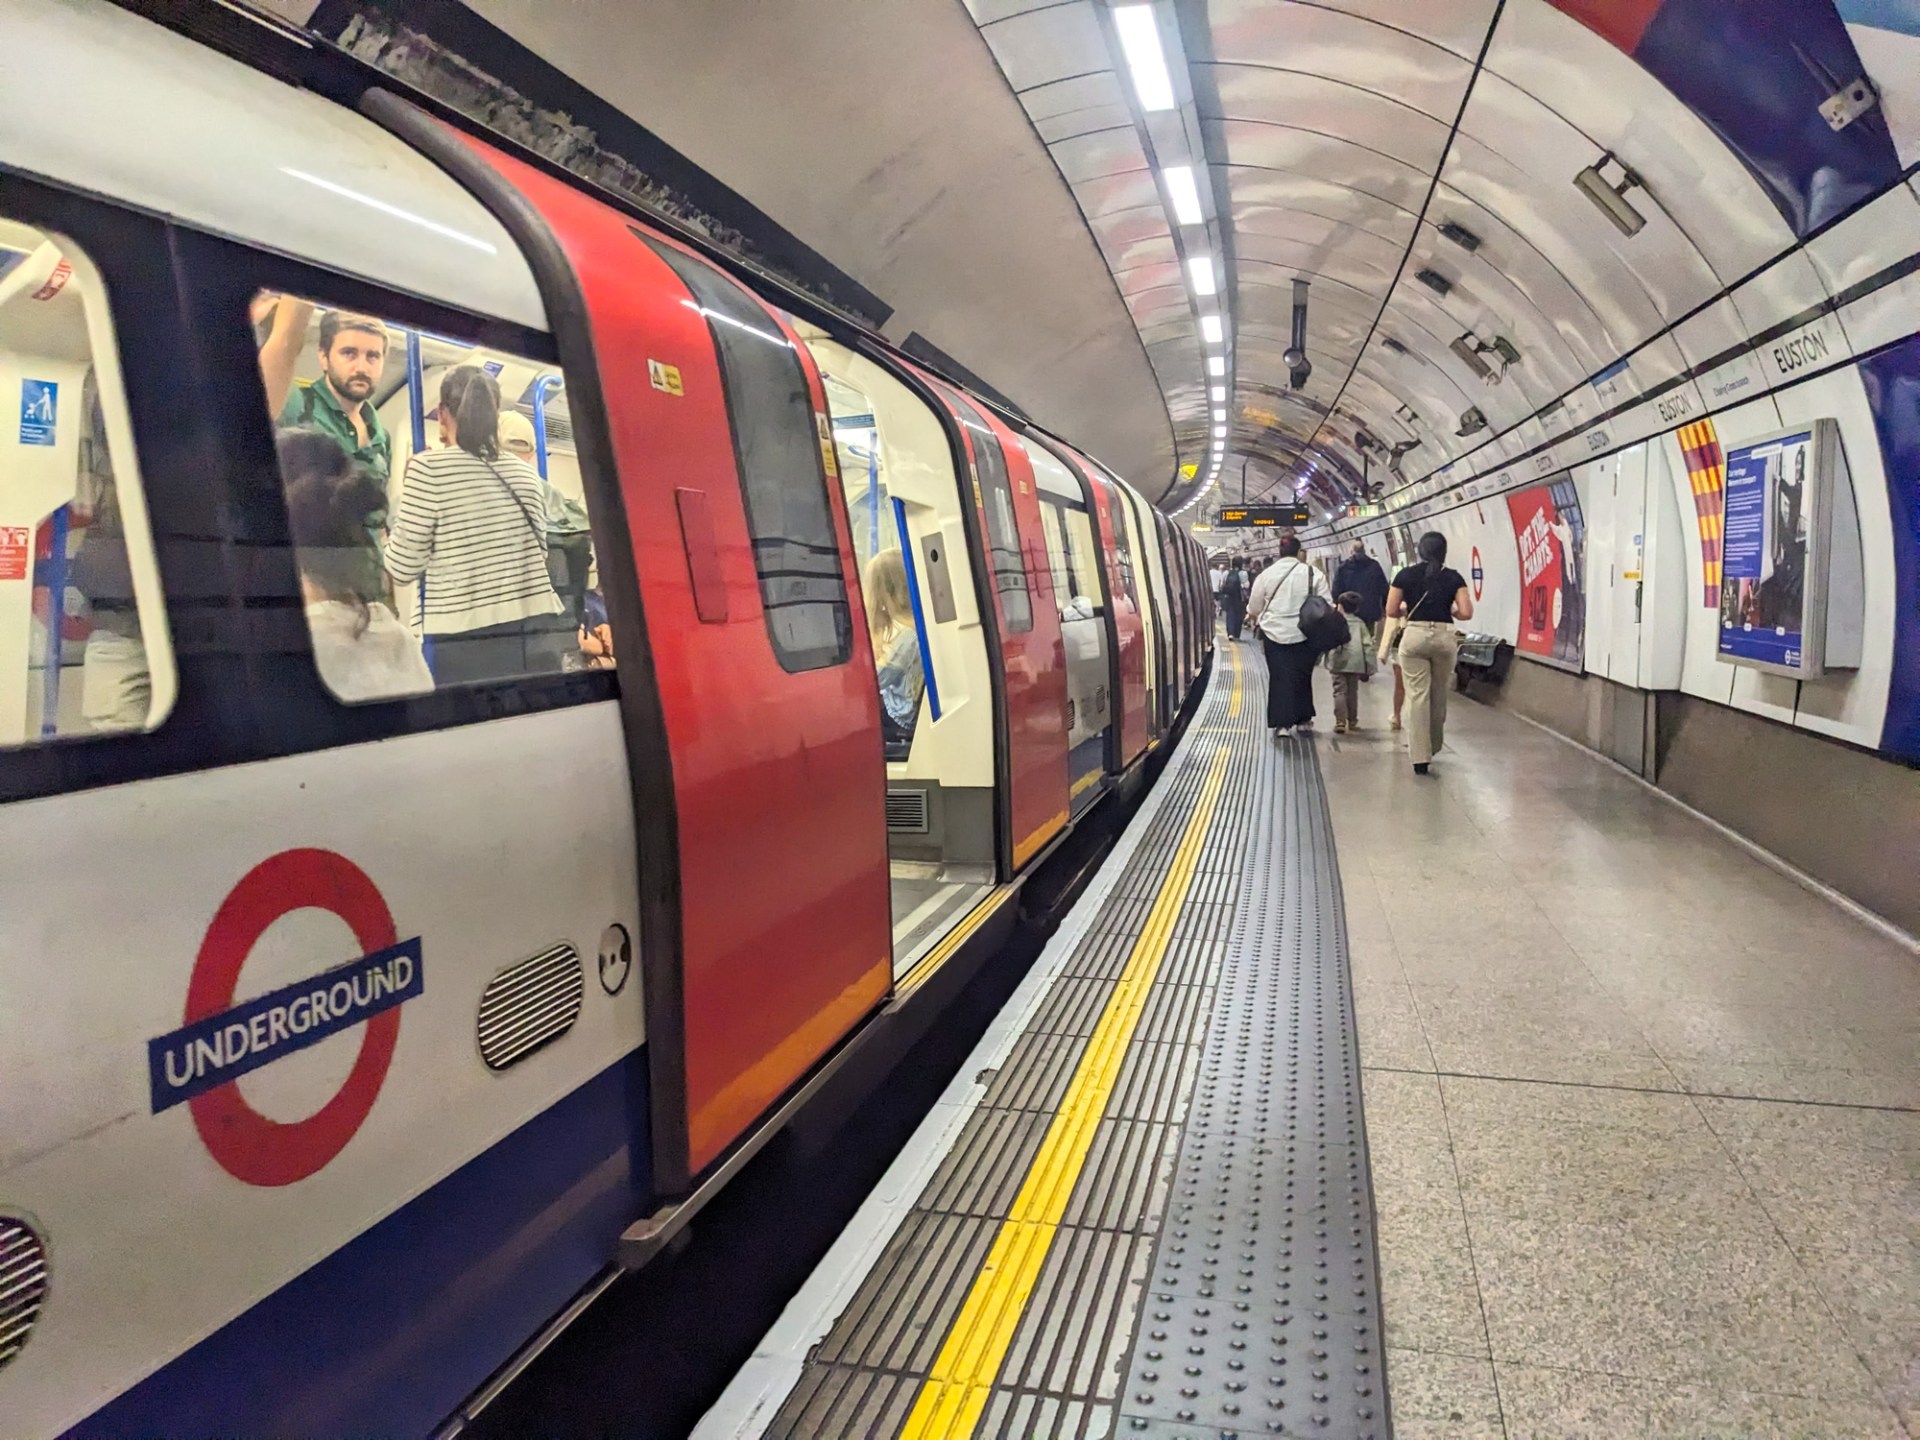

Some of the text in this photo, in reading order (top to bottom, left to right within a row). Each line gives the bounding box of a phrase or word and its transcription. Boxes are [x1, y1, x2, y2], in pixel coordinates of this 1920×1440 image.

[1773, 330, 1829, 373] EUSTON
[1658, 391, 1693, 422] EUSTON
[164, 955, 414, 1088] UNDERGROUND
